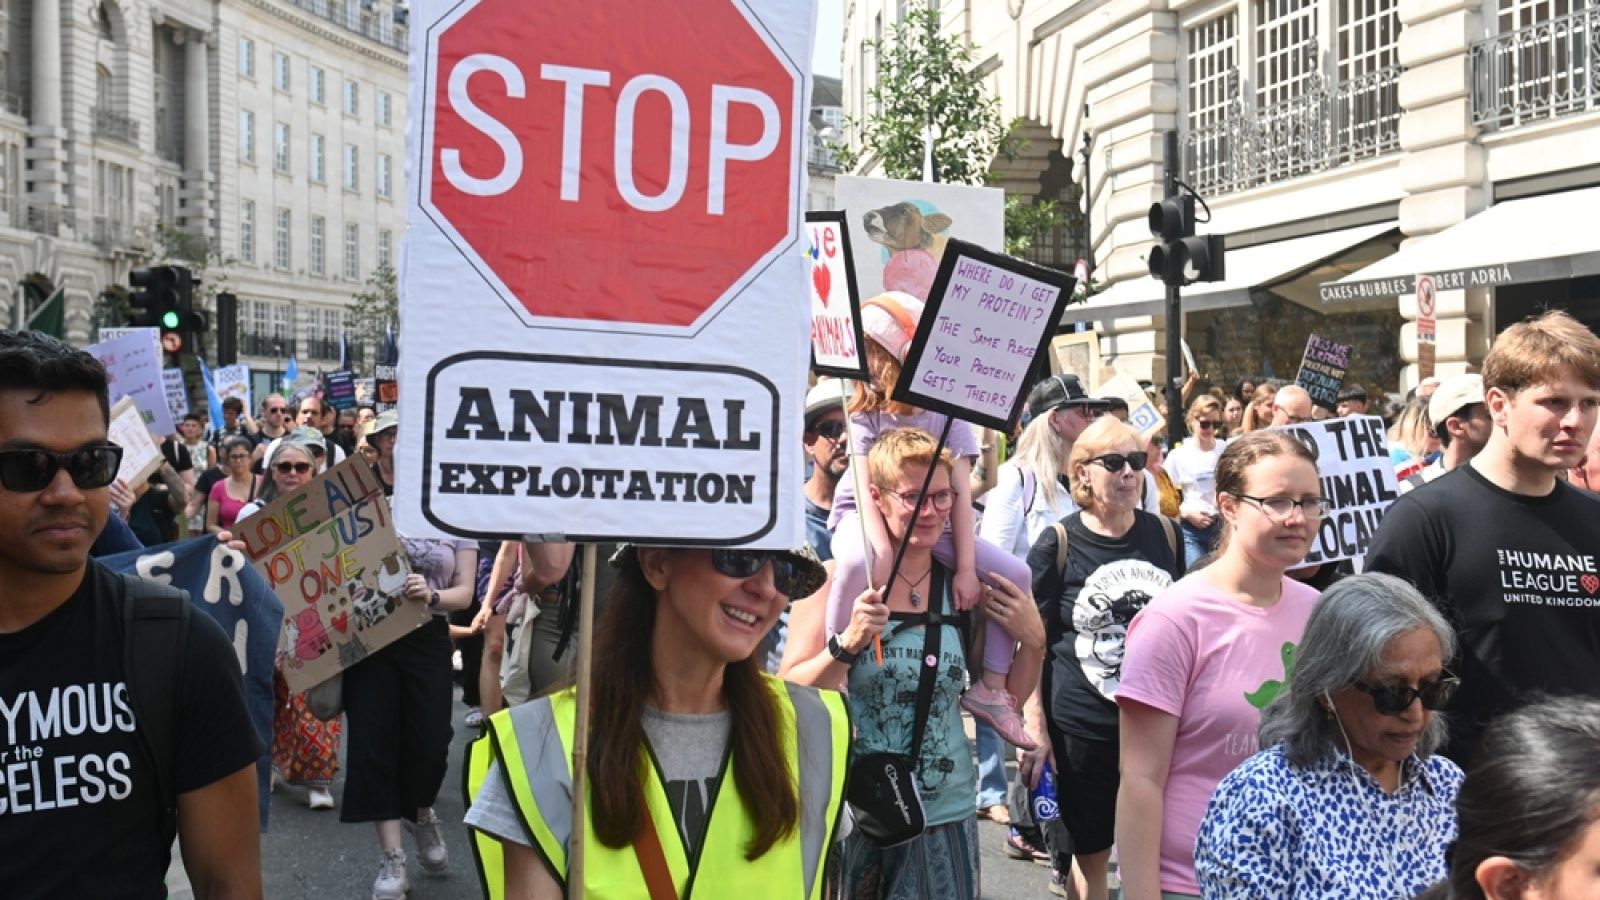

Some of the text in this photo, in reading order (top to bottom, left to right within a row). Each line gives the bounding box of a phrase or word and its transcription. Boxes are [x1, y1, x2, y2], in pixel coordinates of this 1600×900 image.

[440, 53, 781, 216] STOP
[951, 283, 971, 302] MY
[958, 261, 1055, 304] WHERE DO I GET
[1436, 271, 1465, 289] BERT
[938, 316, 962, 337] THE
[1006, 338, 1037, 359] PLACE
[922, 370, 956, 392] GETS
[934, 346, 1017, 382] YOUR PROTEIN
[445, 386, 761, 451] ANIMAL
[1325, 419, 1390, 461] THE
[438, 462, 754, 505] EXPLOITATION
[1319, 468, 1397, 510] IMAL
[241, 463, 379, 560] LOVE ALL
[317, 489, 385, 559] JUST
[300, 546, 366, 604] ONE
[1500, 570, 1579, 593] LEAGUE
[1505, 549, 1597, 573] HUMANE
[1503, 593, 1600, 607] UNITED KINGDOM
[0, 682, 136, 746] YMOUS
[15, 744, 44, 762] the
[0, 752, 133, 815] ELESS
